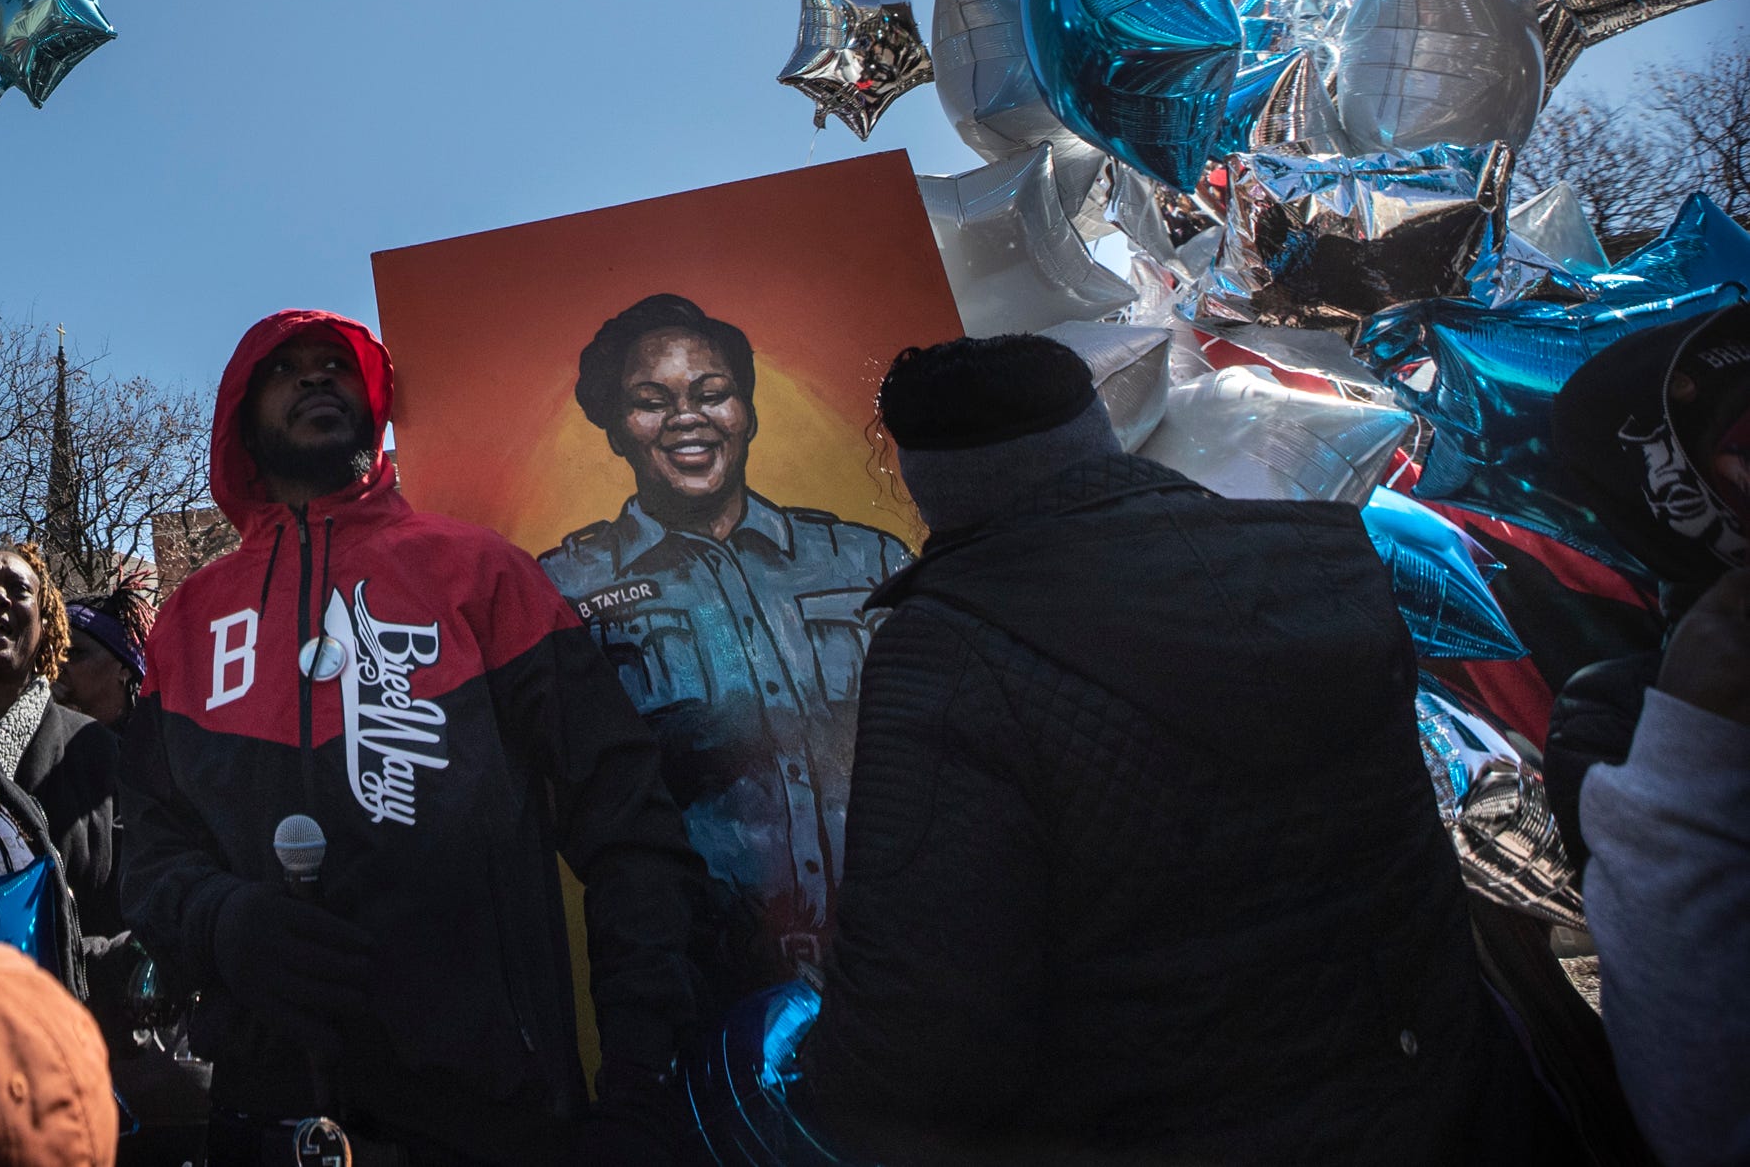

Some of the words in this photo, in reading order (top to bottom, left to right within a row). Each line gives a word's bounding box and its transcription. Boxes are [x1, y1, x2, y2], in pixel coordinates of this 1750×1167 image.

[578, 602, 593, 619] B.
[591, 583, 653, 610] TAYLOR
[206, 607, 259, 712] B
